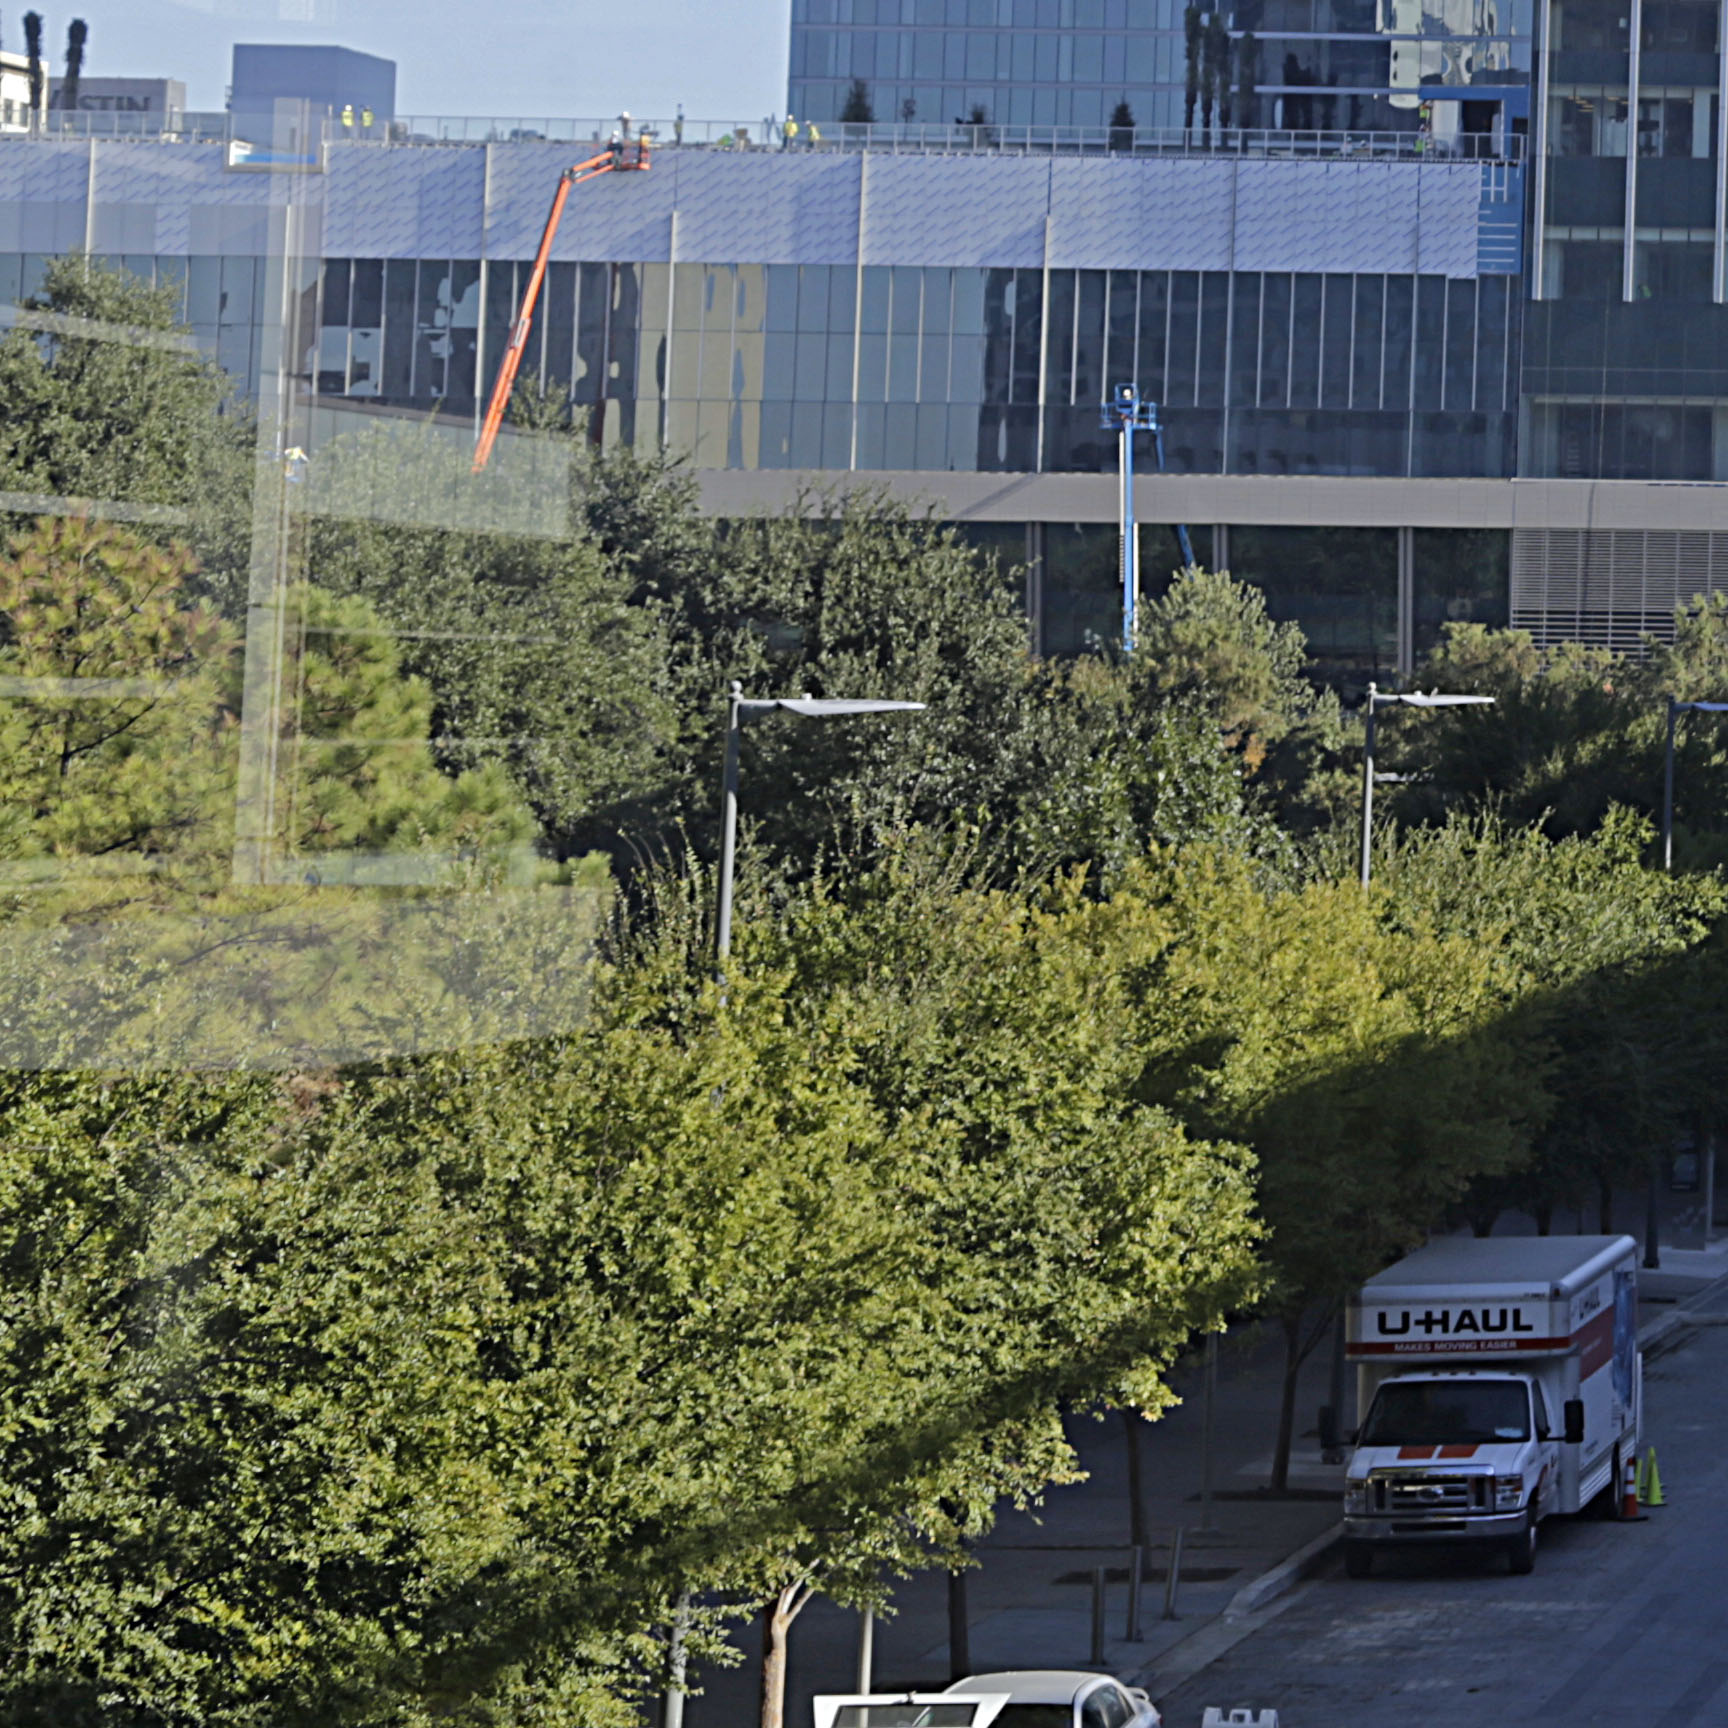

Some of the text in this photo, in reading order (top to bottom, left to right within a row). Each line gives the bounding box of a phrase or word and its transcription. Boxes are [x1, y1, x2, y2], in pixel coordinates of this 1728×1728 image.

[1378, 1308, 1533, 1335] U-HAUL
[1394, 1340, 1518, 1353] MAKES MOVING EASIER
